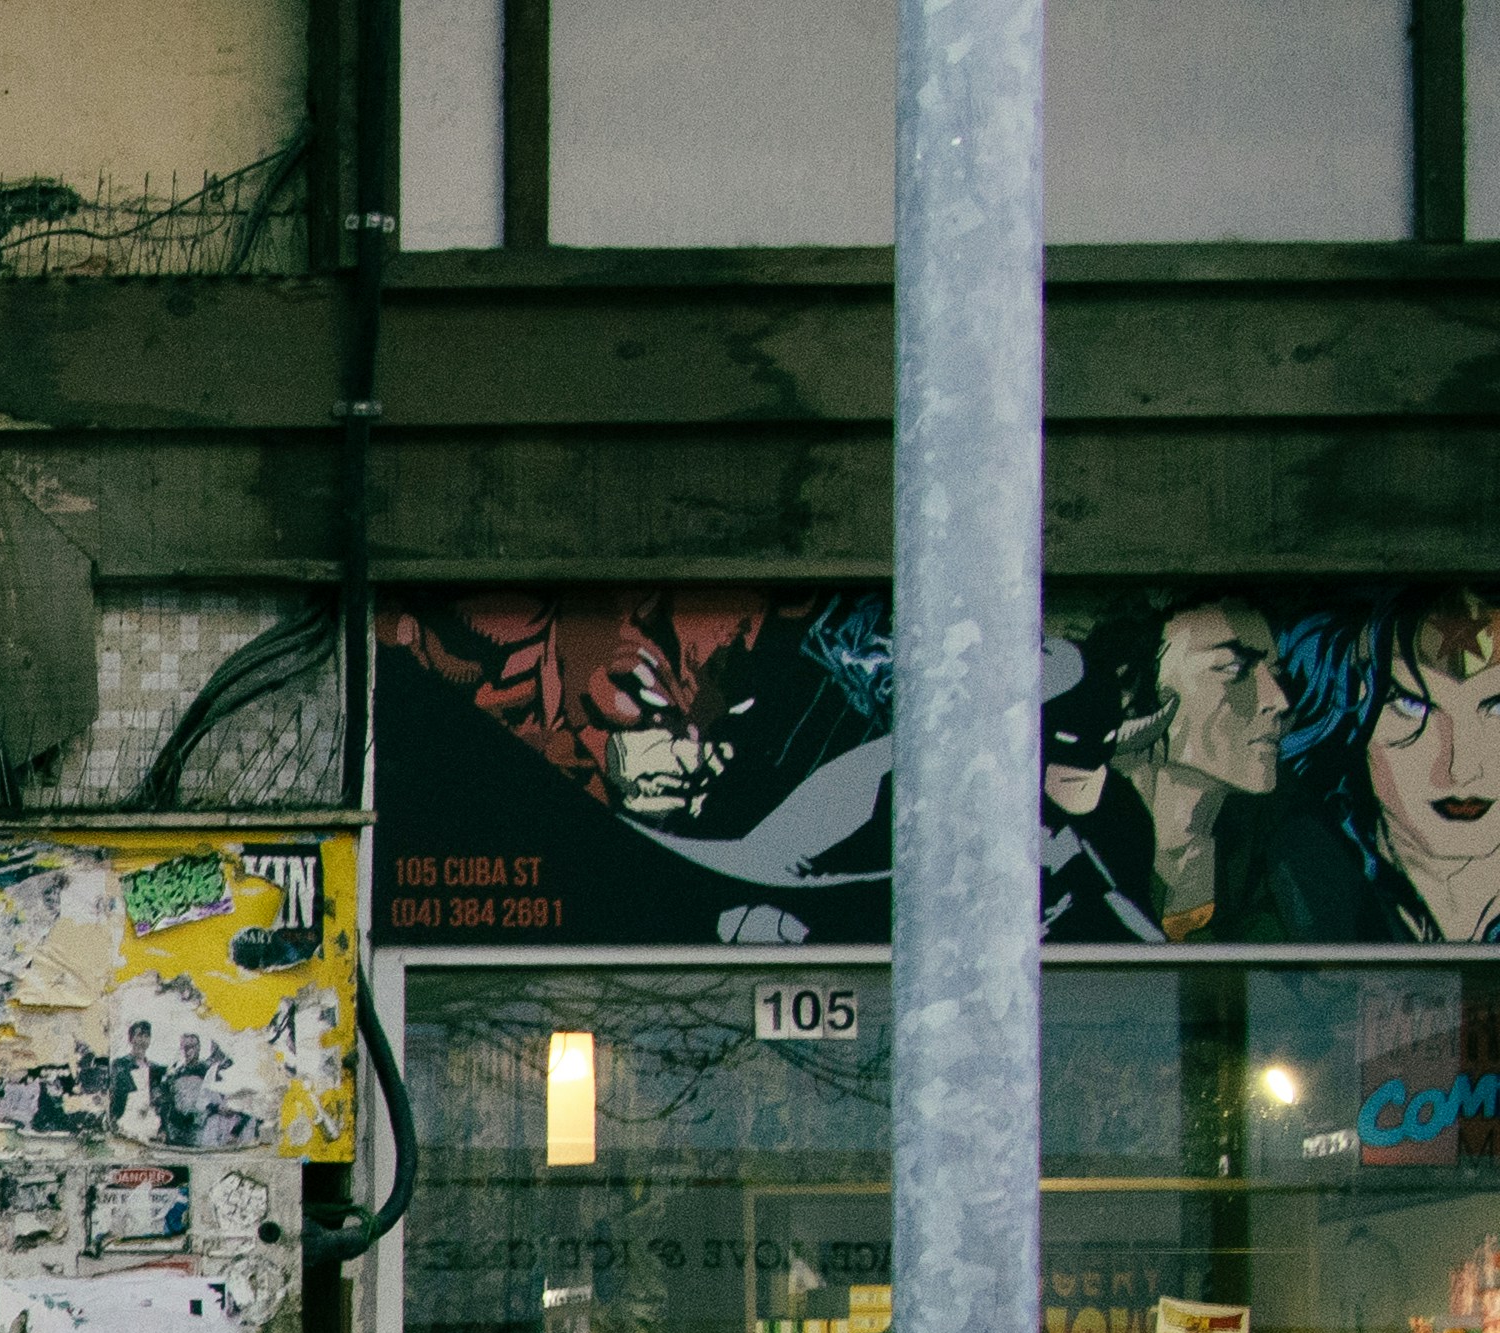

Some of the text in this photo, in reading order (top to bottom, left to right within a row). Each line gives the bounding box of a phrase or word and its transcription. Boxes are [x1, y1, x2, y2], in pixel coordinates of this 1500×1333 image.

[396, 856, 543, 887] 105 CUBA ST
[391, 896, 563, 928] (04) 384 2691
[763, 990, 855, 1034] 105
